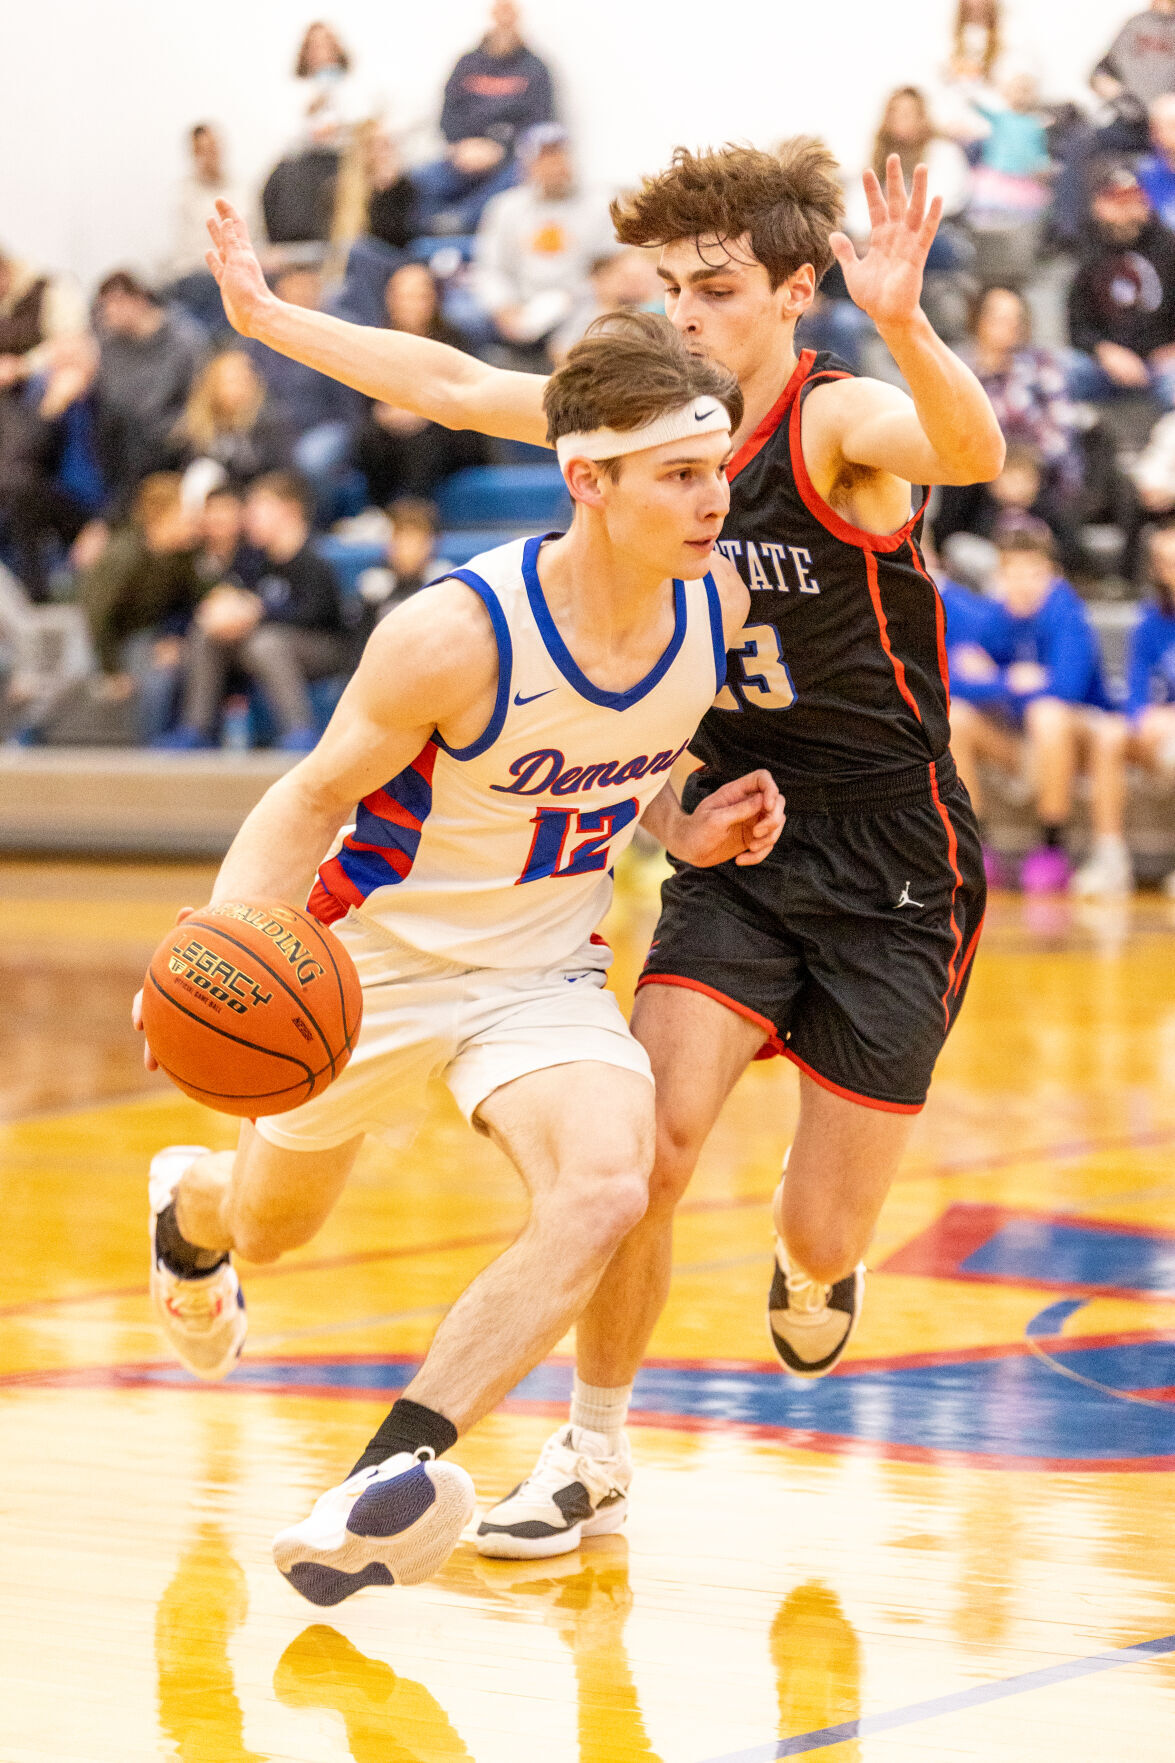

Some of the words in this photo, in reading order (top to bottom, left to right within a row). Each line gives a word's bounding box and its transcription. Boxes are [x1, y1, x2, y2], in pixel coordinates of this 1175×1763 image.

[713, 539, 820, 594] TATE
[711, 622, 799, 713] 3
[513, 796, 640, 886] 12
[170, 933, 273, 1008] LEGACY
[183, 967, 249, 1015] 1000
